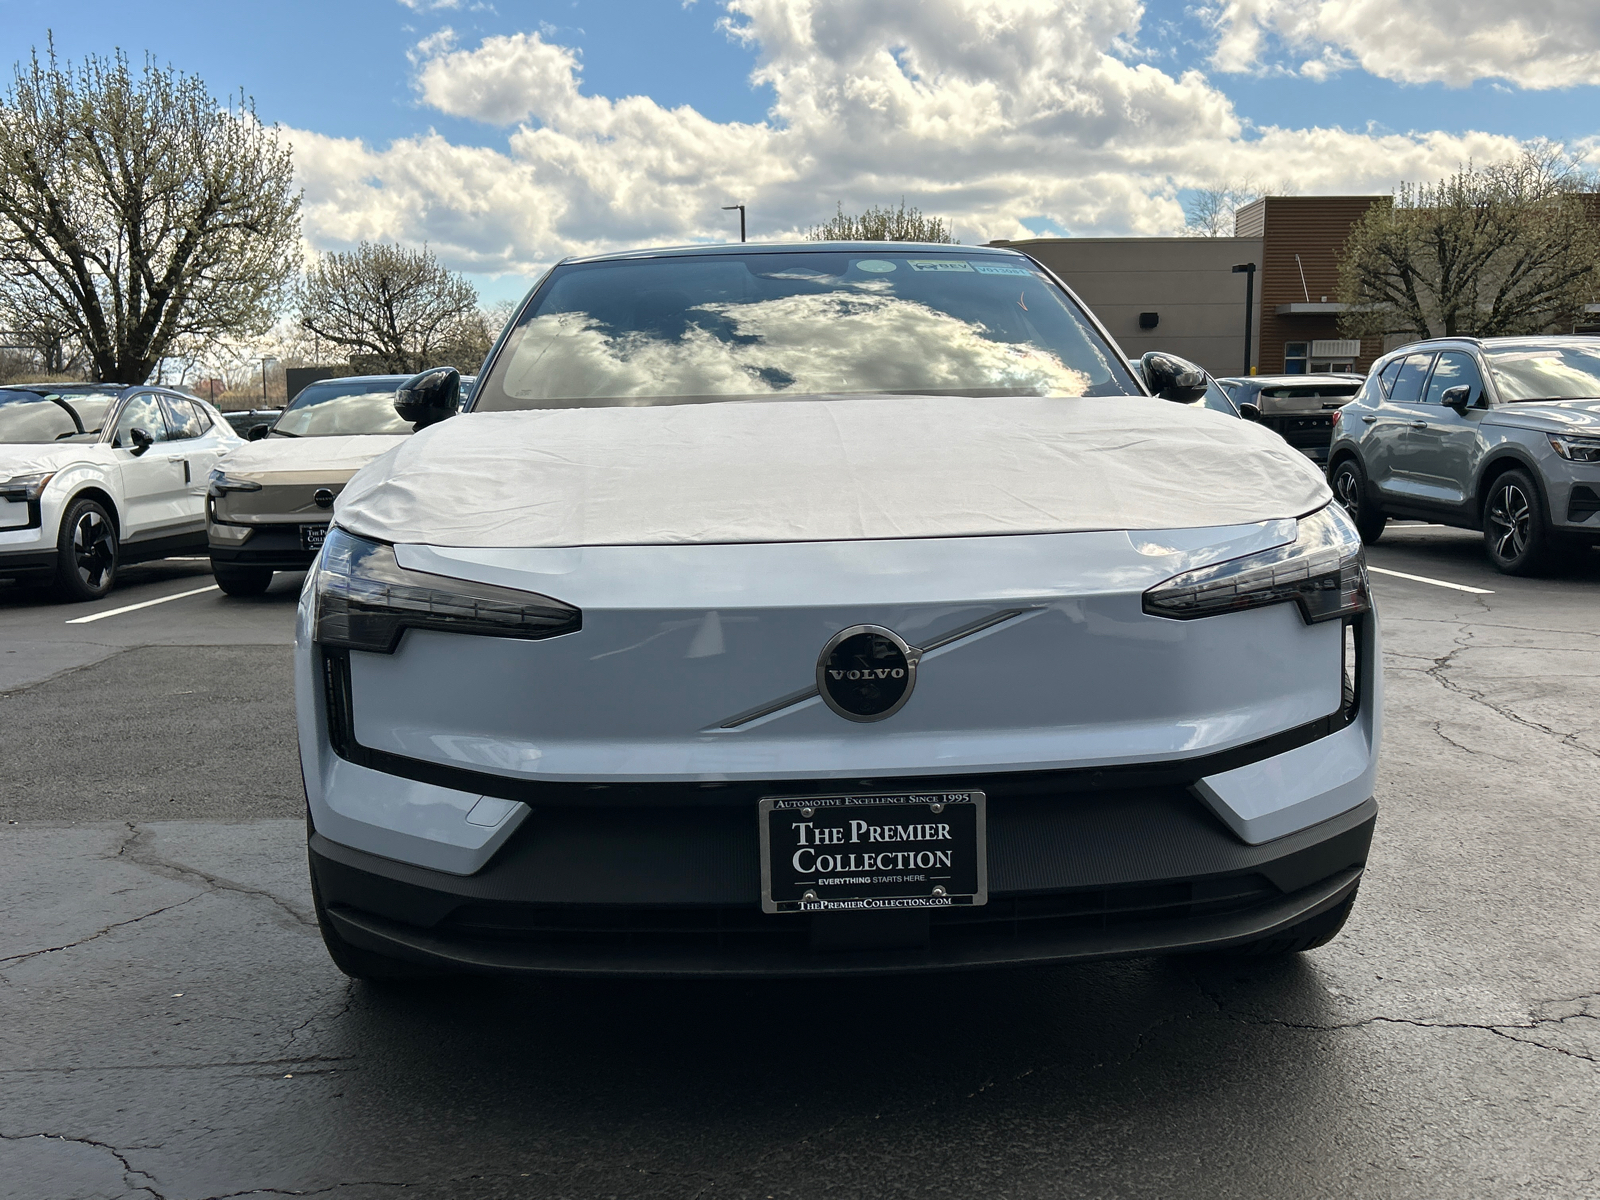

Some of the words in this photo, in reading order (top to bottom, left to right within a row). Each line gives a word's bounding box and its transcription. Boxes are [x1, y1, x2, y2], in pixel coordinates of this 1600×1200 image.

[829, 668, 904, 680] VOLVO
[776, 797, 841, 809] AUTOMOTIVE
[845, 795, 906, 805] EXCELLENCE
[908, 794, 939, 803] SINCE
[942, 793, 970, 803] 1995
[792, 822, 844, 846] THE
[849, 820, 952, 843] PREMIER
[792, 848, 952, 874] COLLECTION
[818, 877, 871, 885] EVERYTHING
[872, 876, 902, 884] STARTS
